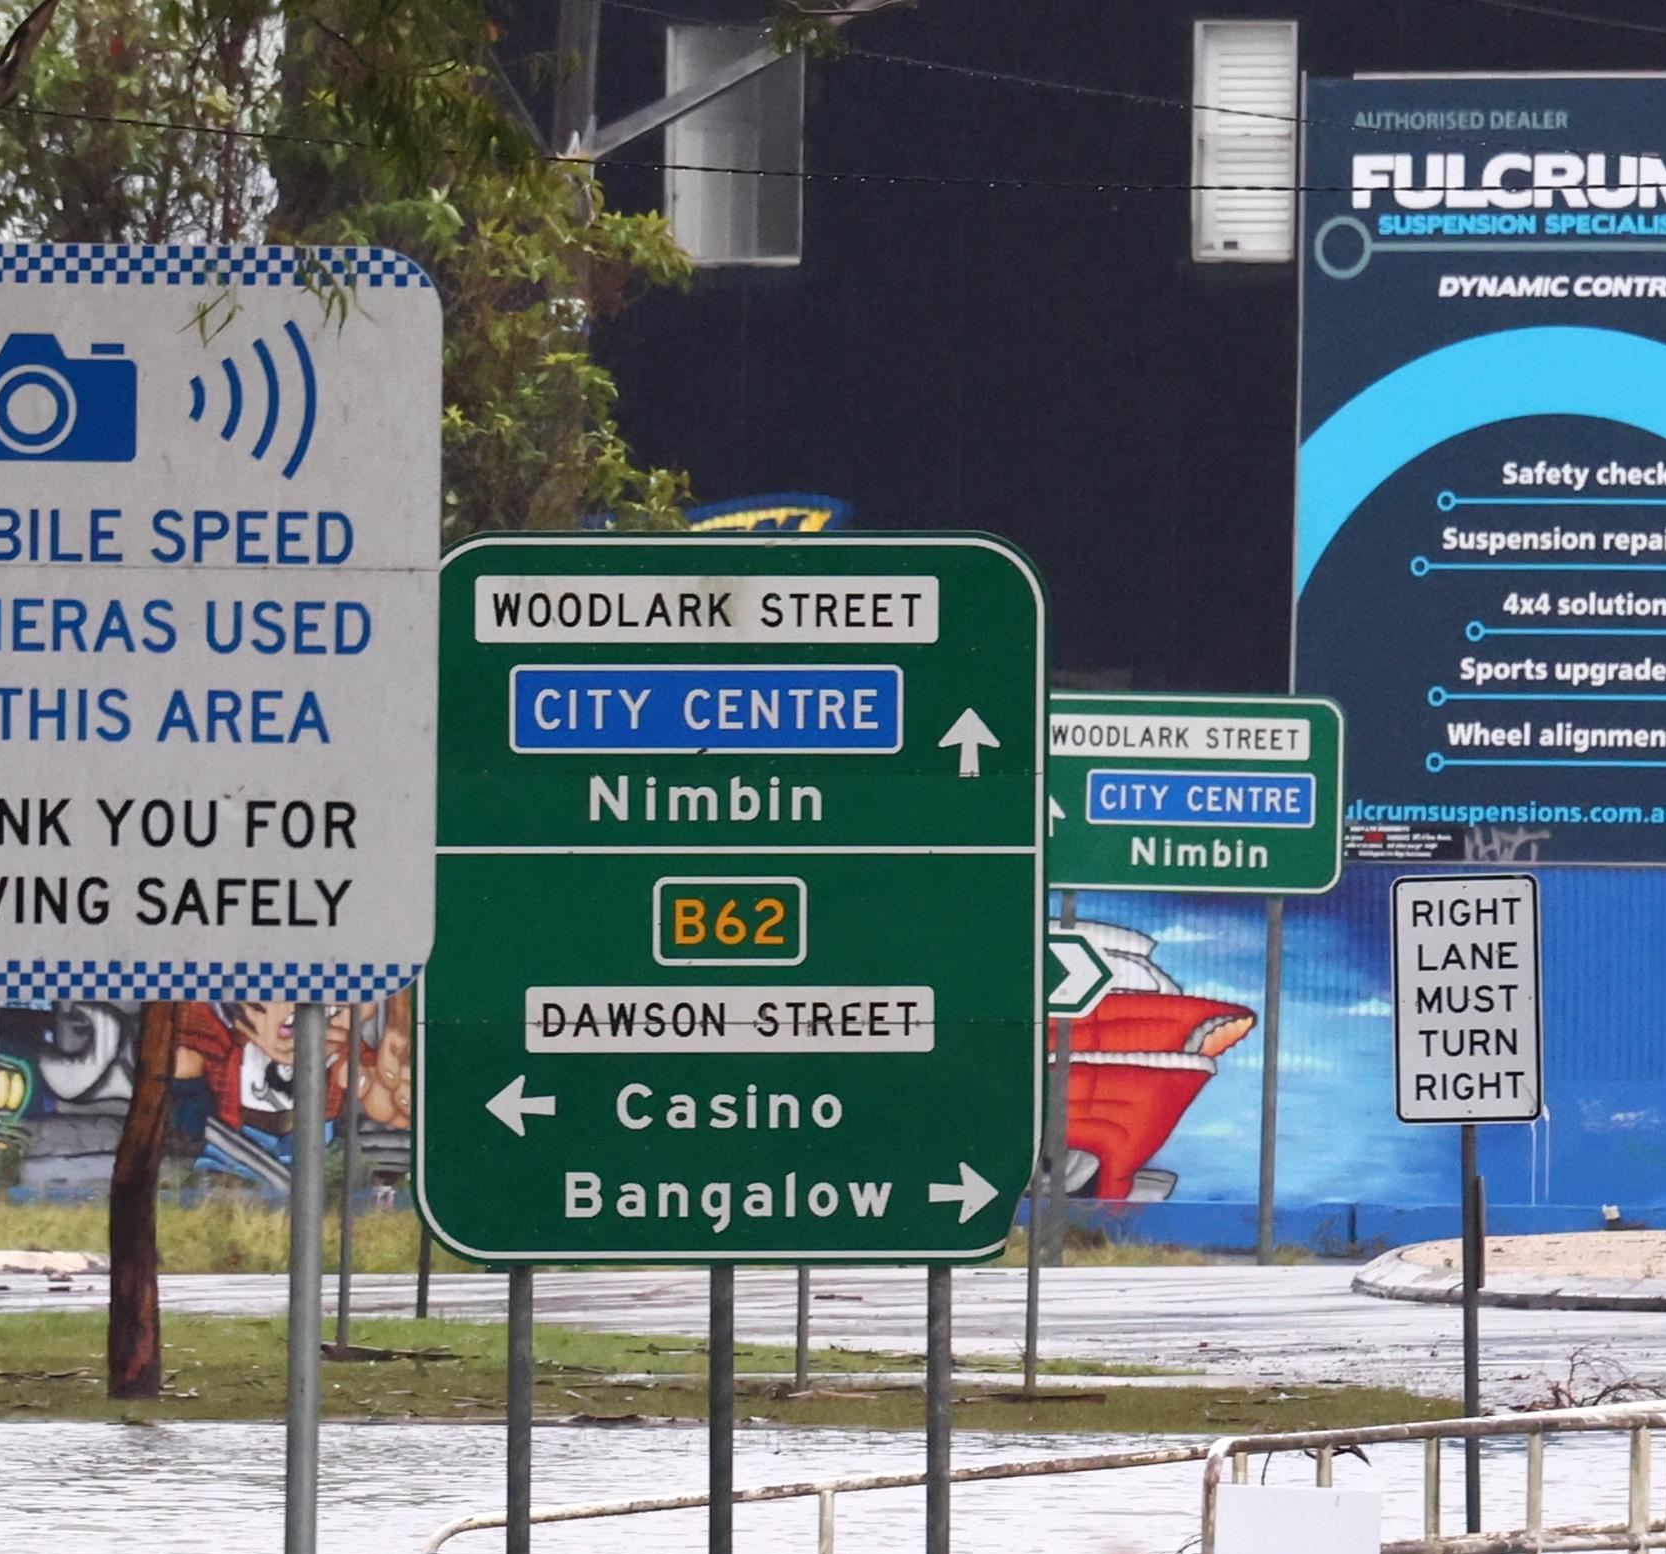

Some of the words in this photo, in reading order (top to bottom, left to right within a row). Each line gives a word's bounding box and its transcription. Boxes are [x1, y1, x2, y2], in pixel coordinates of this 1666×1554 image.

[1354, 111, 1485, 131] AUTHORISED
[1490, 111, 1568, 130] DEALER
[1378, 214, 1536, 235] SUSPENSION
[1438, 275, 1570, 298] DYNAMIC
[1502, 461, 1589, 491] Safety
[150, 509, 355, 565] SPEED
[1442, 527, 1597, 555] Suspension
[492, 592, 733, 629] WOODLARK
[760, 593, 923, 629] STREET
[1503, 592, 1551, 616] 4x4
[205, 600, 373, 656] USED
[1460, 657, 1548, 685] Sports
[157, 690, 331, 745] AREA
[533, 689, 652, 731] CITY
[684, 688, 880, 731] CENTRE
[1050, 724, 1190, 748] WOODLARK
[1205, 727, 1300, 751] STREET
[1447, 722, 1532, 748] Wheel
[589, 774, 825, 823] Nimbin
[1100, 784, 1169, 810] CITY
[1186, 785, 1301, 813] CENTRE
[97, 799, 219, 848] YOU
[246, 801, 358, 849] FOR
[1130, 836, 1268, 868] Nimbin
[136, 877, 353, 927] SAFELY
[1412, 897, 1521, 928] RIGHT
[673, 898, 786, 946] B62
[1417, 941, 1519, 971] LANE
[1416, 984, 1519, 1015] MUST
[541, 1002, 728, 1039] DAWSON
[757, 1001, 919, 1039] STREET
[1418, 1028, 1518, 1058] TURN
[1415, 1071, 1525, 1101] RIGHT
[615, 1082, 845, 1130] Casino
[564, 1171, 894, 1234] Bangalow
